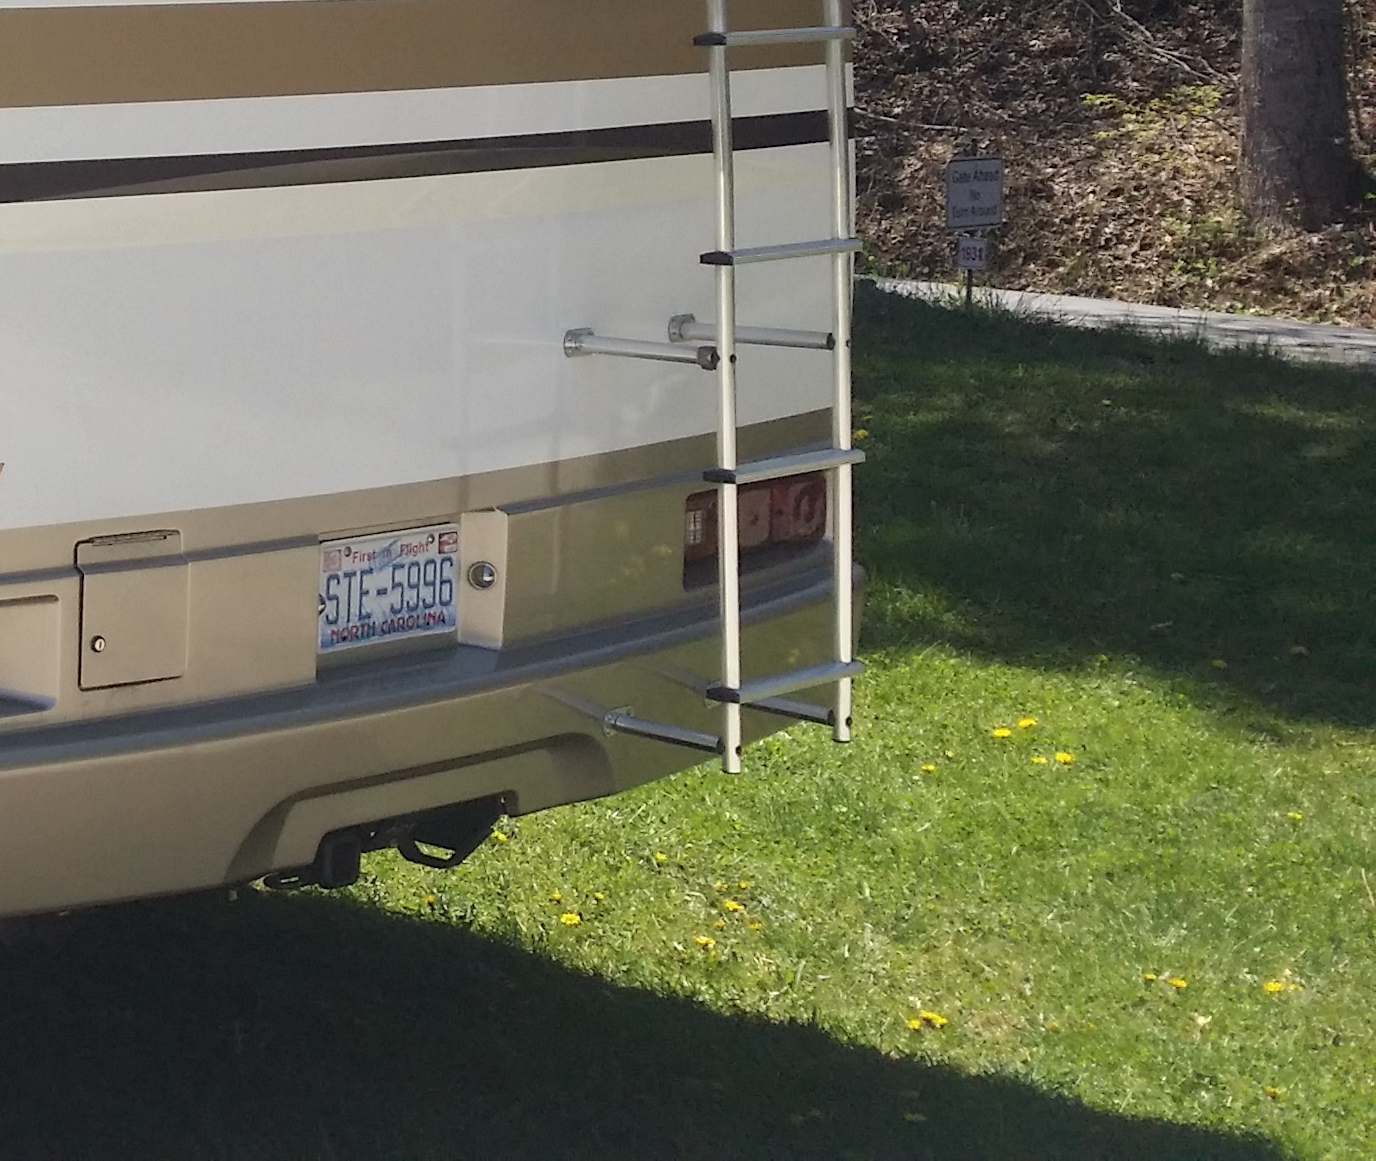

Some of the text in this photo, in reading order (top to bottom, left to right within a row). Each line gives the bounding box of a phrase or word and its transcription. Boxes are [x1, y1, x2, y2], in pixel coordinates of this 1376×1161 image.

[352, 550, 376, 564] First
[399, 541, 429, 557] Flight
[325, 556, 454, 625] STE-5996
[330, 610, 446, 644] NORTH CAROLINA
